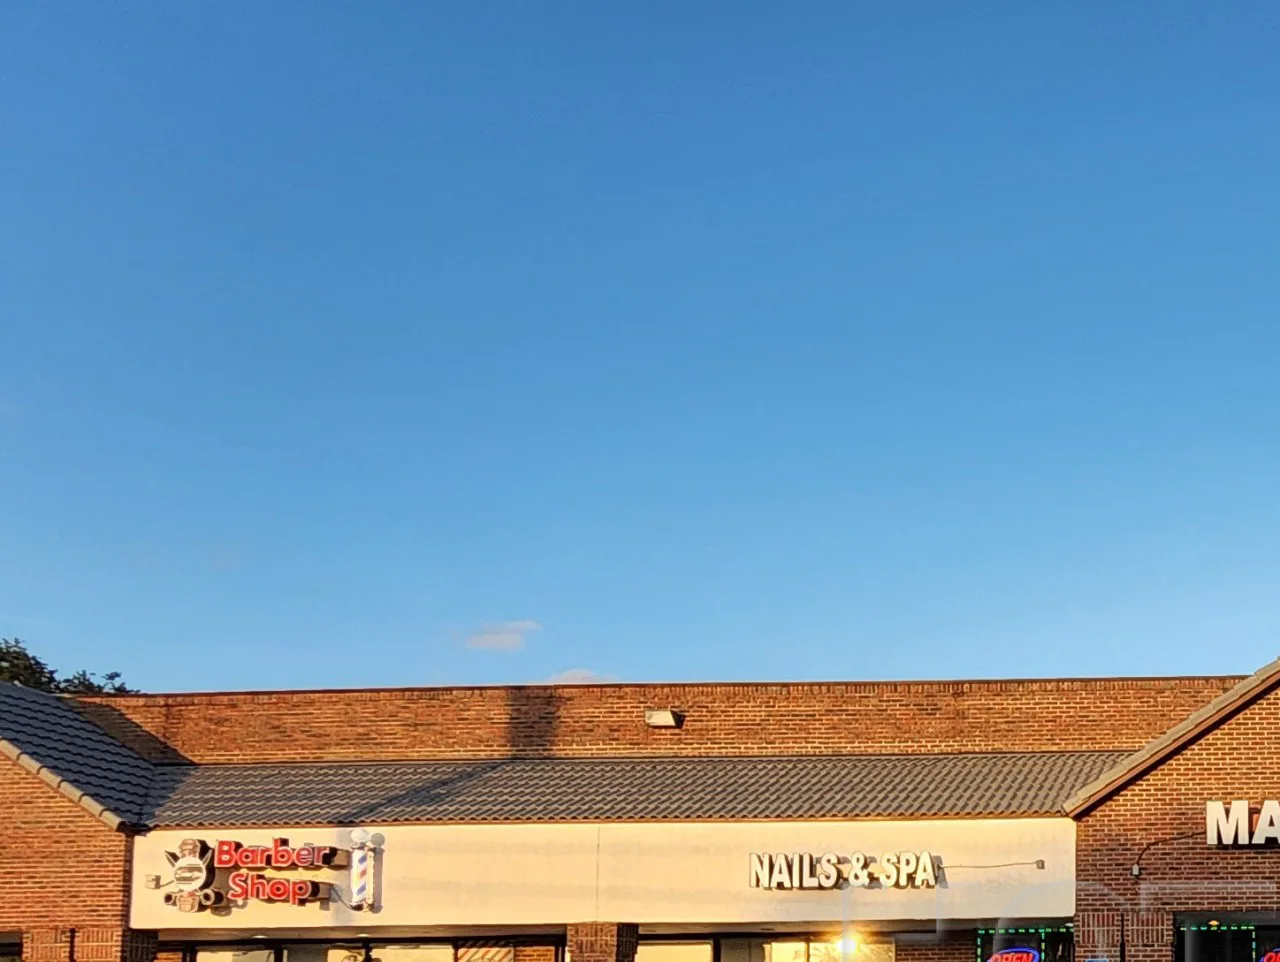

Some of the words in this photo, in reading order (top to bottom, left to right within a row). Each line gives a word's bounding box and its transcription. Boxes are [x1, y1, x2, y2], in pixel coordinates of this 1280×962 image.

[214, 838, 330, 868] Barber
[749, 851, 839, 890] NAILS
[848, 851, 871, 888] &
[880, 850, 937, 889] SPA
[227, 872, 312, 905] Shop
